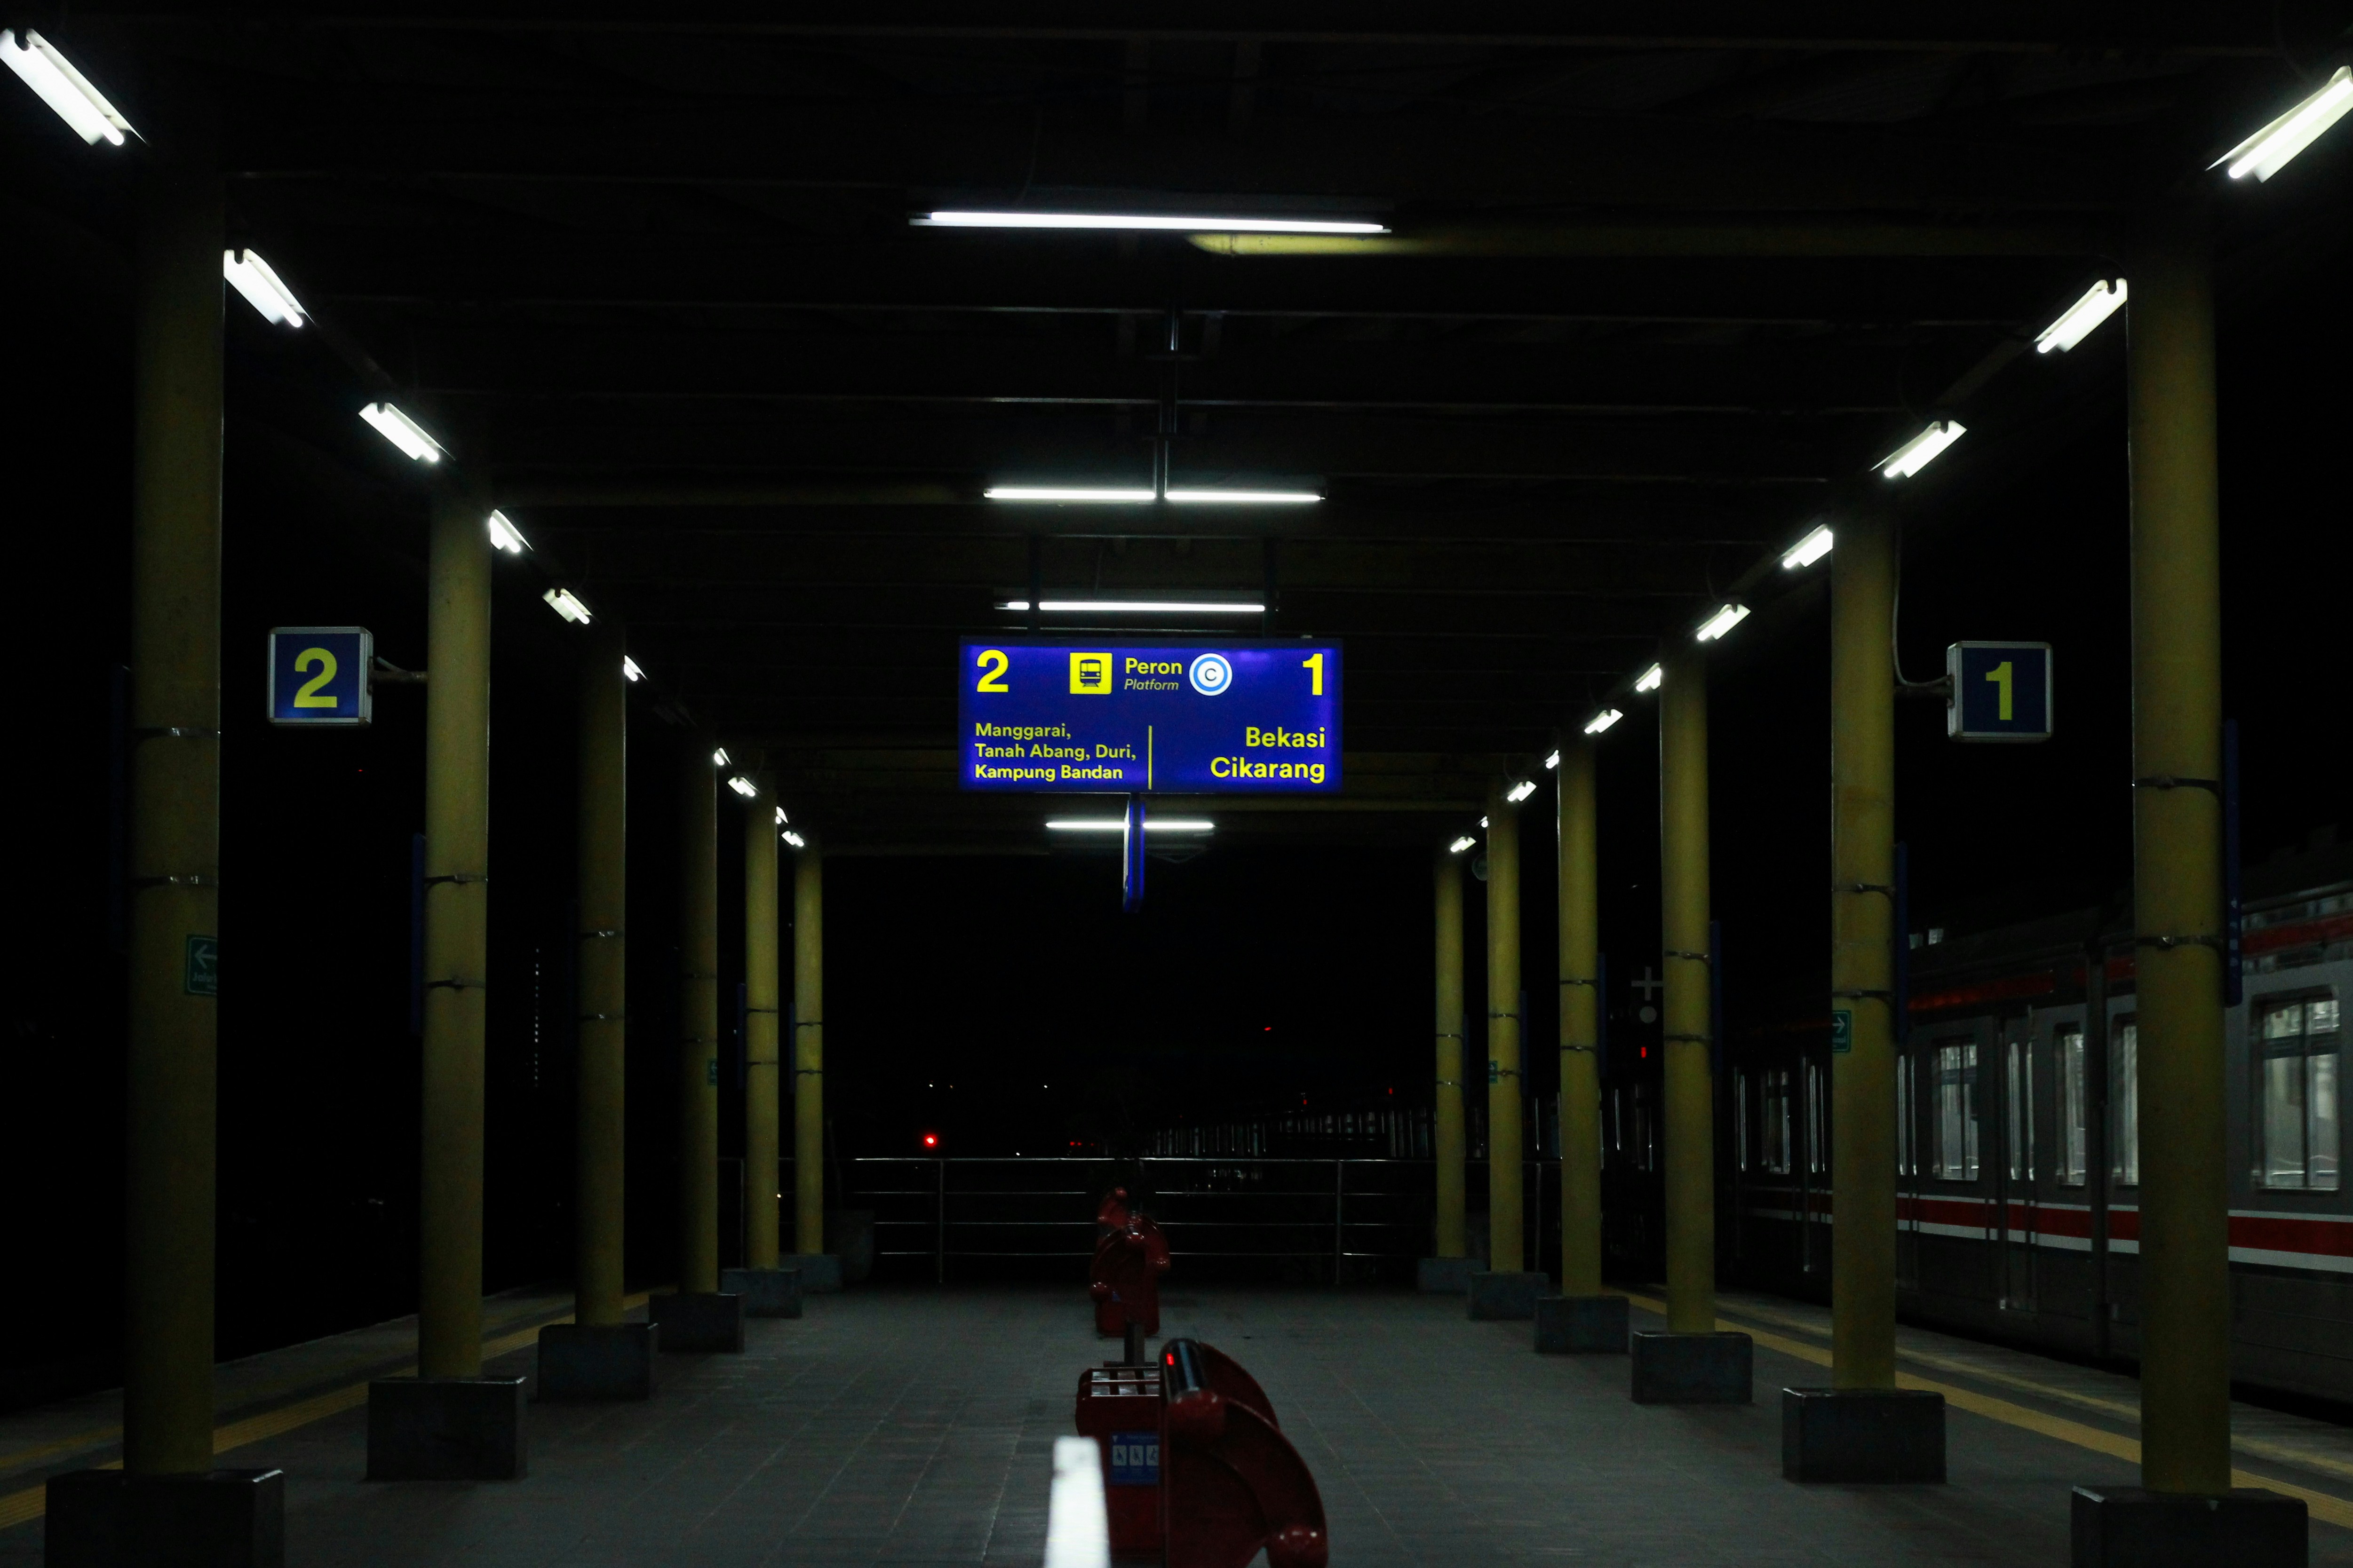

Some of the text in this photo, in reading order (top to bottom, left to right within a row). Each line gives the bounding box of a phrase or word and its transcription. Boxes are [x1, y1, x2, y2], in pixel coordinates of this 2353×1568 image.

[977, 649, 1009, 693] 2
[1125, 657, 1183, 675] Peron
[1205, 668, 1217, 681] C
[1302, 653, 1323, 696] 1
[294, 647, 338, 708] 2
[1124, 678, 1179, 690] Platform
[1986, 661, 2012, 721] 1
[975, 722, 1071, 740] Manggarai,
[1246, 726, 1325, 748] Bekasi
[975, 743, 1136, 762] Tanah Abang, Duri,
[975, 764, 1123, 782] Kampung Bandan
[1210, 756, 1325, 784] Cikarang
